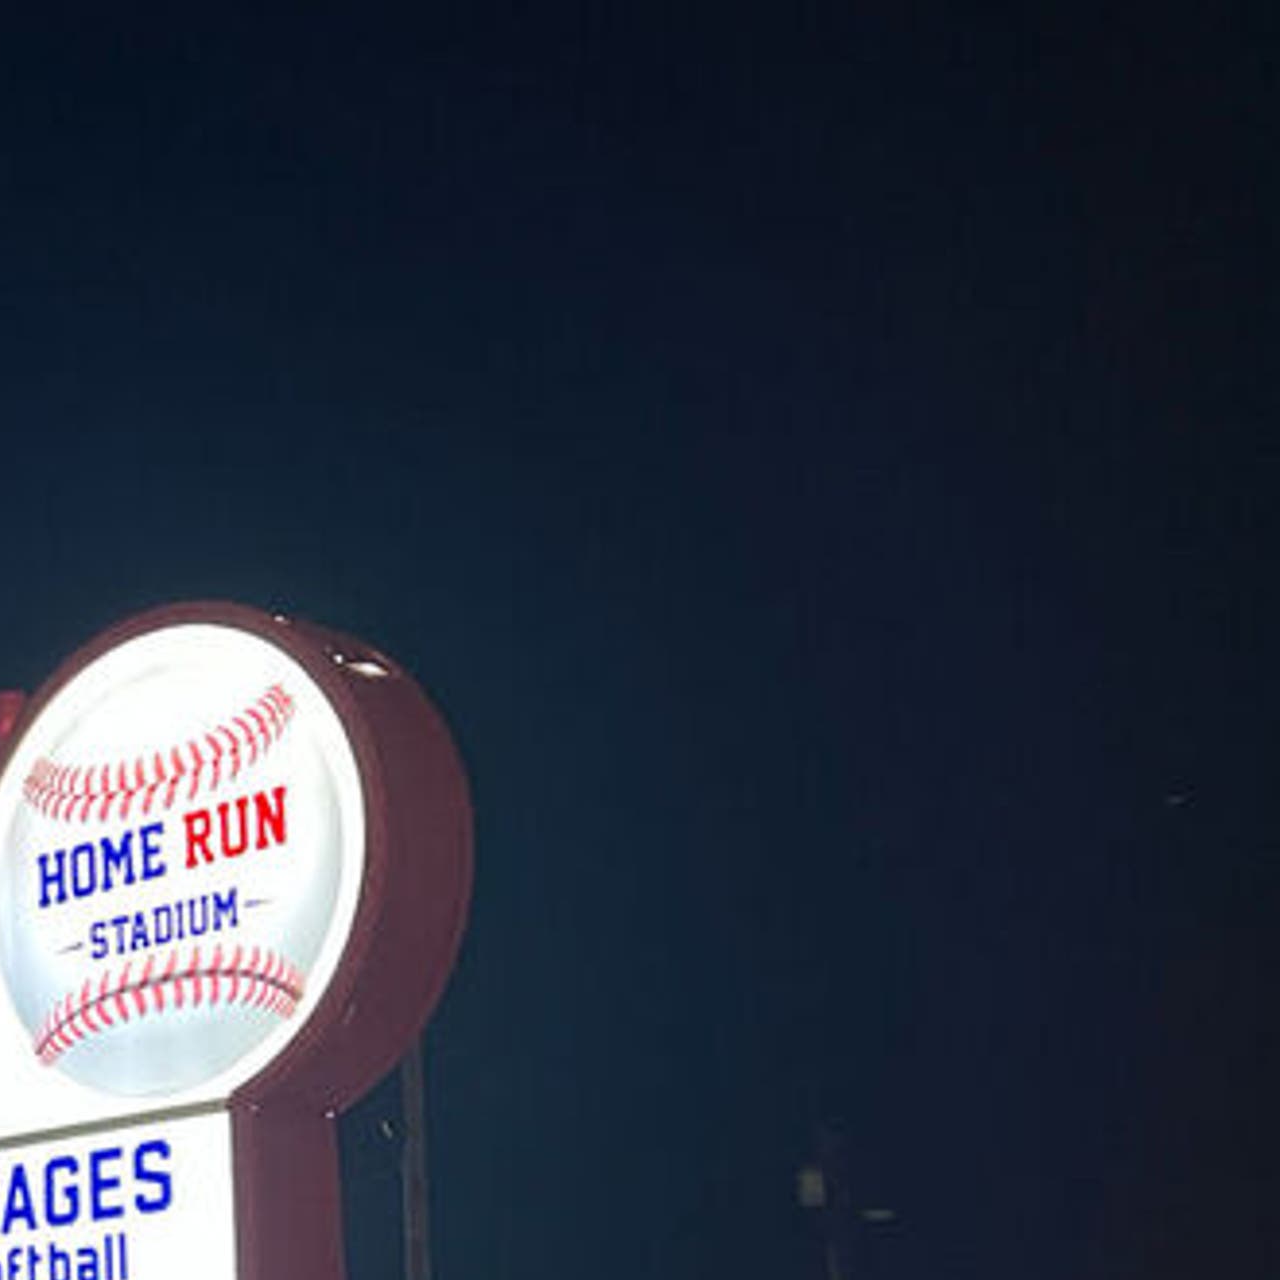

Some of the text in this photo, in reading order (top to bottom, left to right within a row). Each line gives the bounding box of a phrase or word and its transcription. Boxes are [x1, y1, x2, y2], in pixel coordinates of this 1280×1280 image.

[37, 786, 287, 908] HOME RUN
[89, 886, 239, 960] STADIUM
